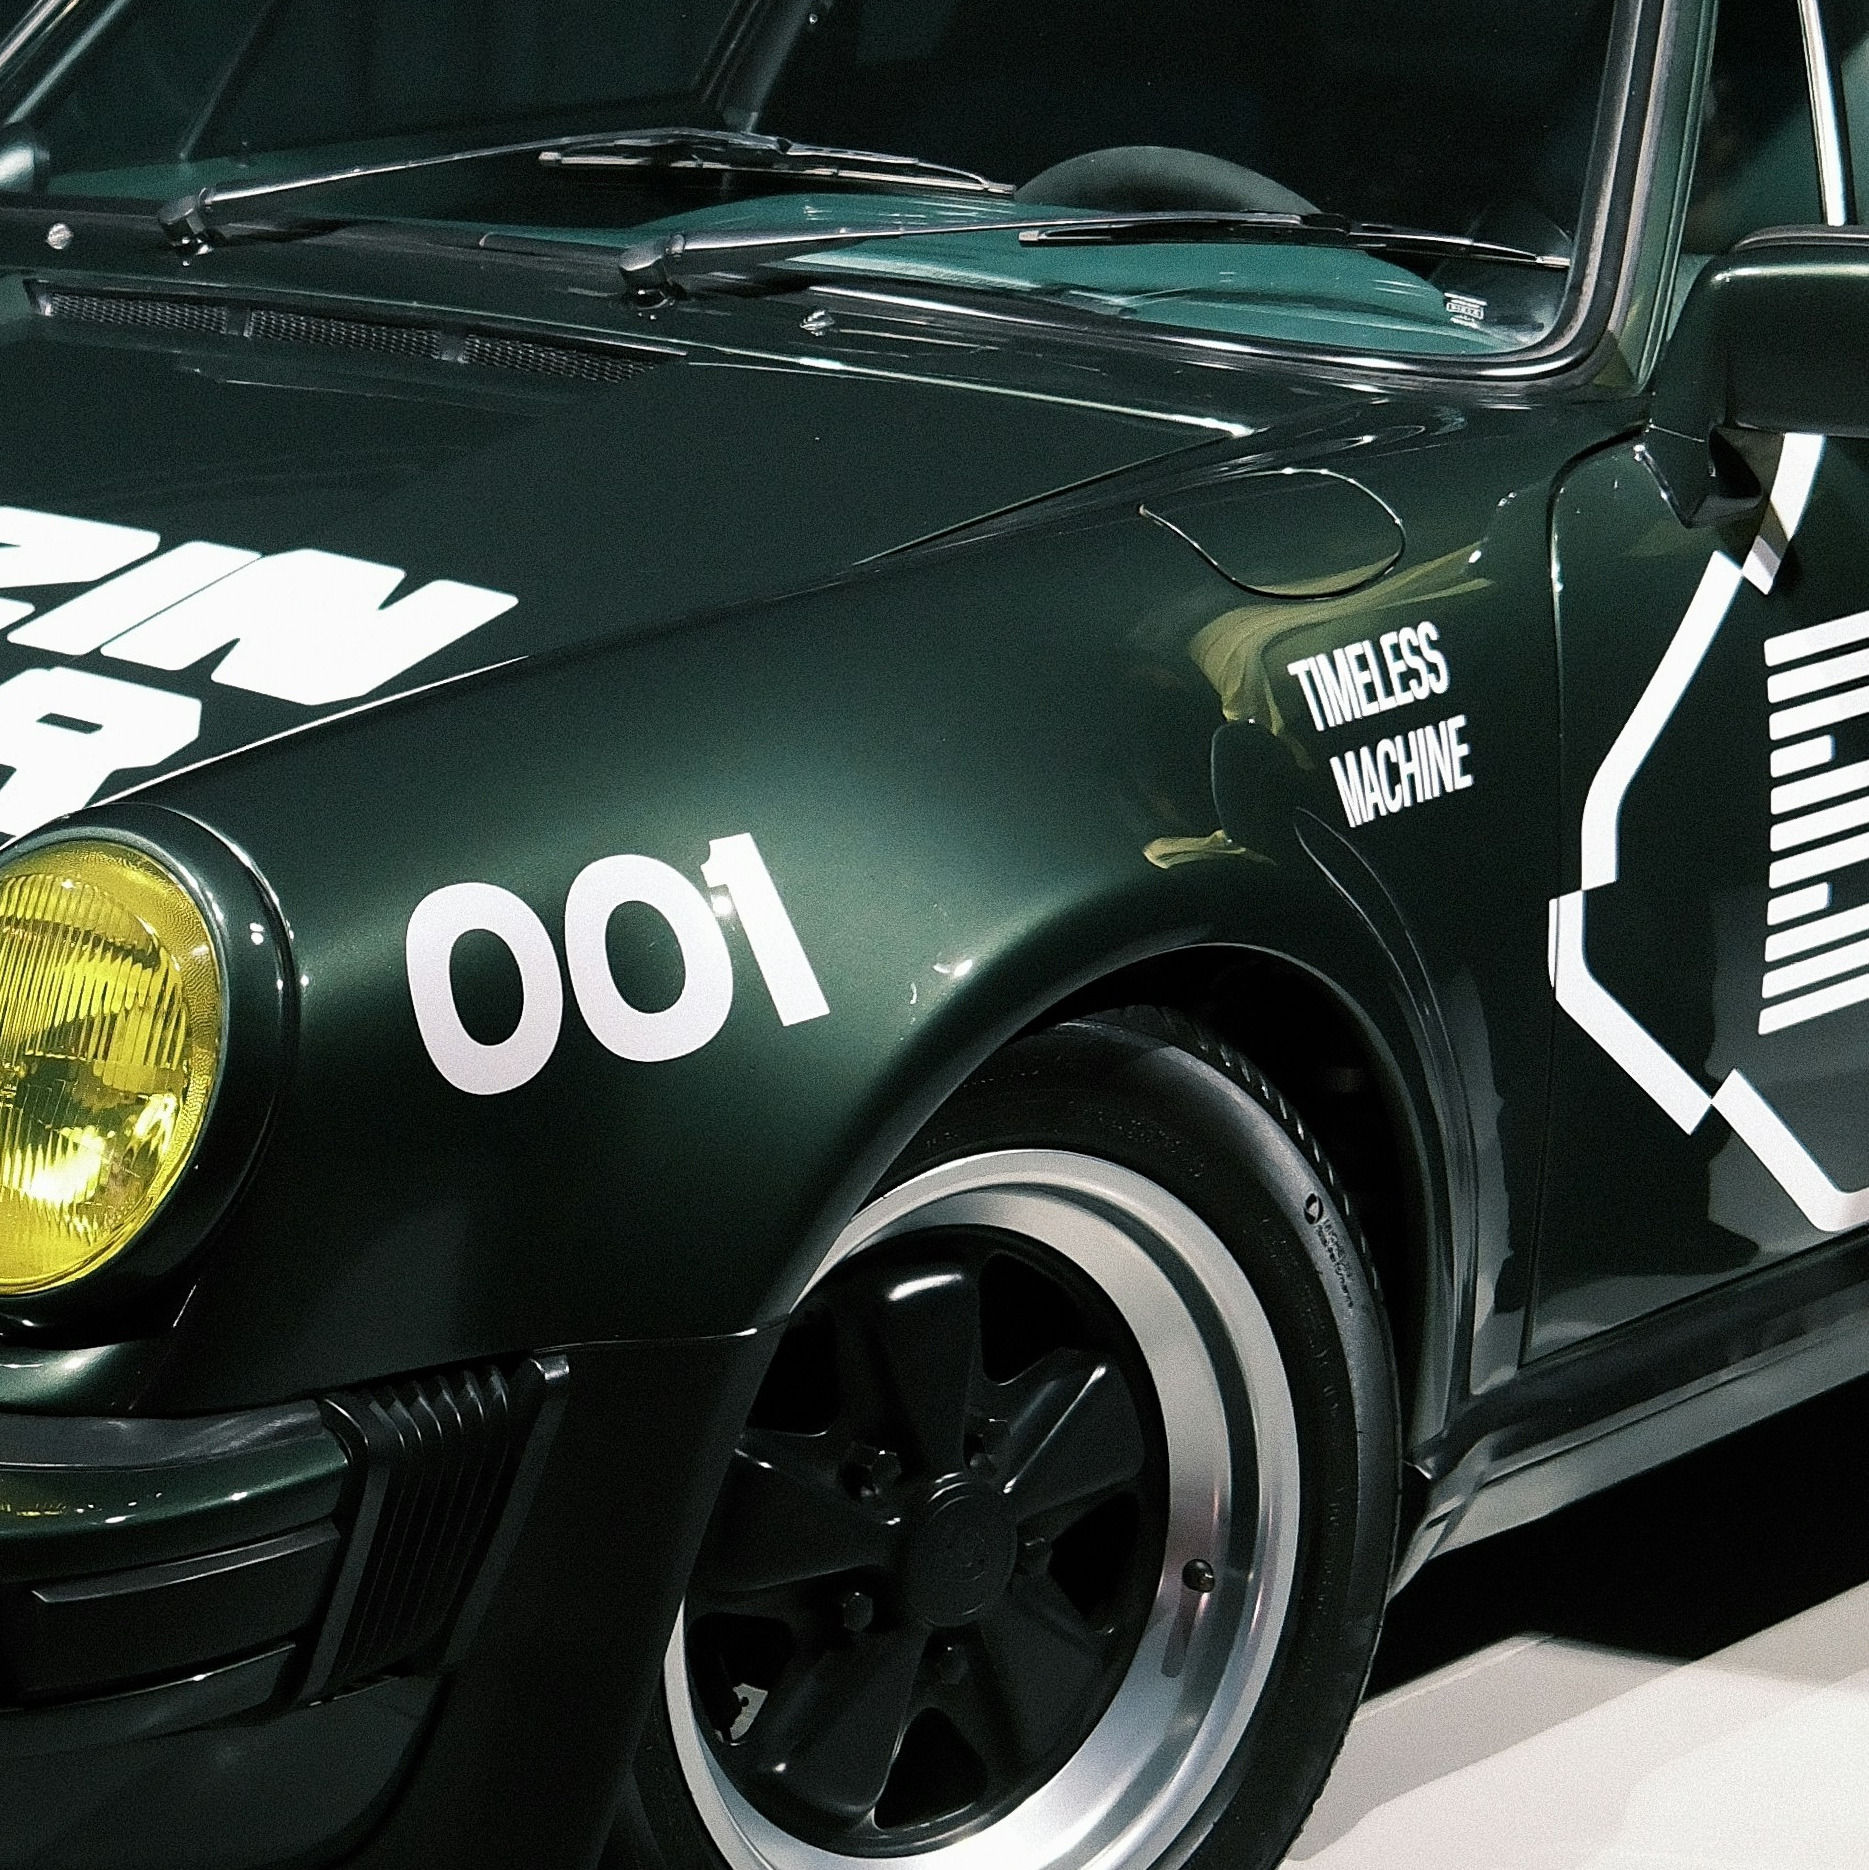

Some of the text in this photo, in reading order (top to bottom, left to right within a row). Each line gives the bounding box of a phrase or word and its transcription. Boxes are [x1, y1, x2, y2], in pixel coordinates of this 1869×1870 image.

[1287, 620, 1450, 732] TIMELESS
[1329, 714, 1474, 829] MACHINE
[405, 831, 831, 1096] 001
